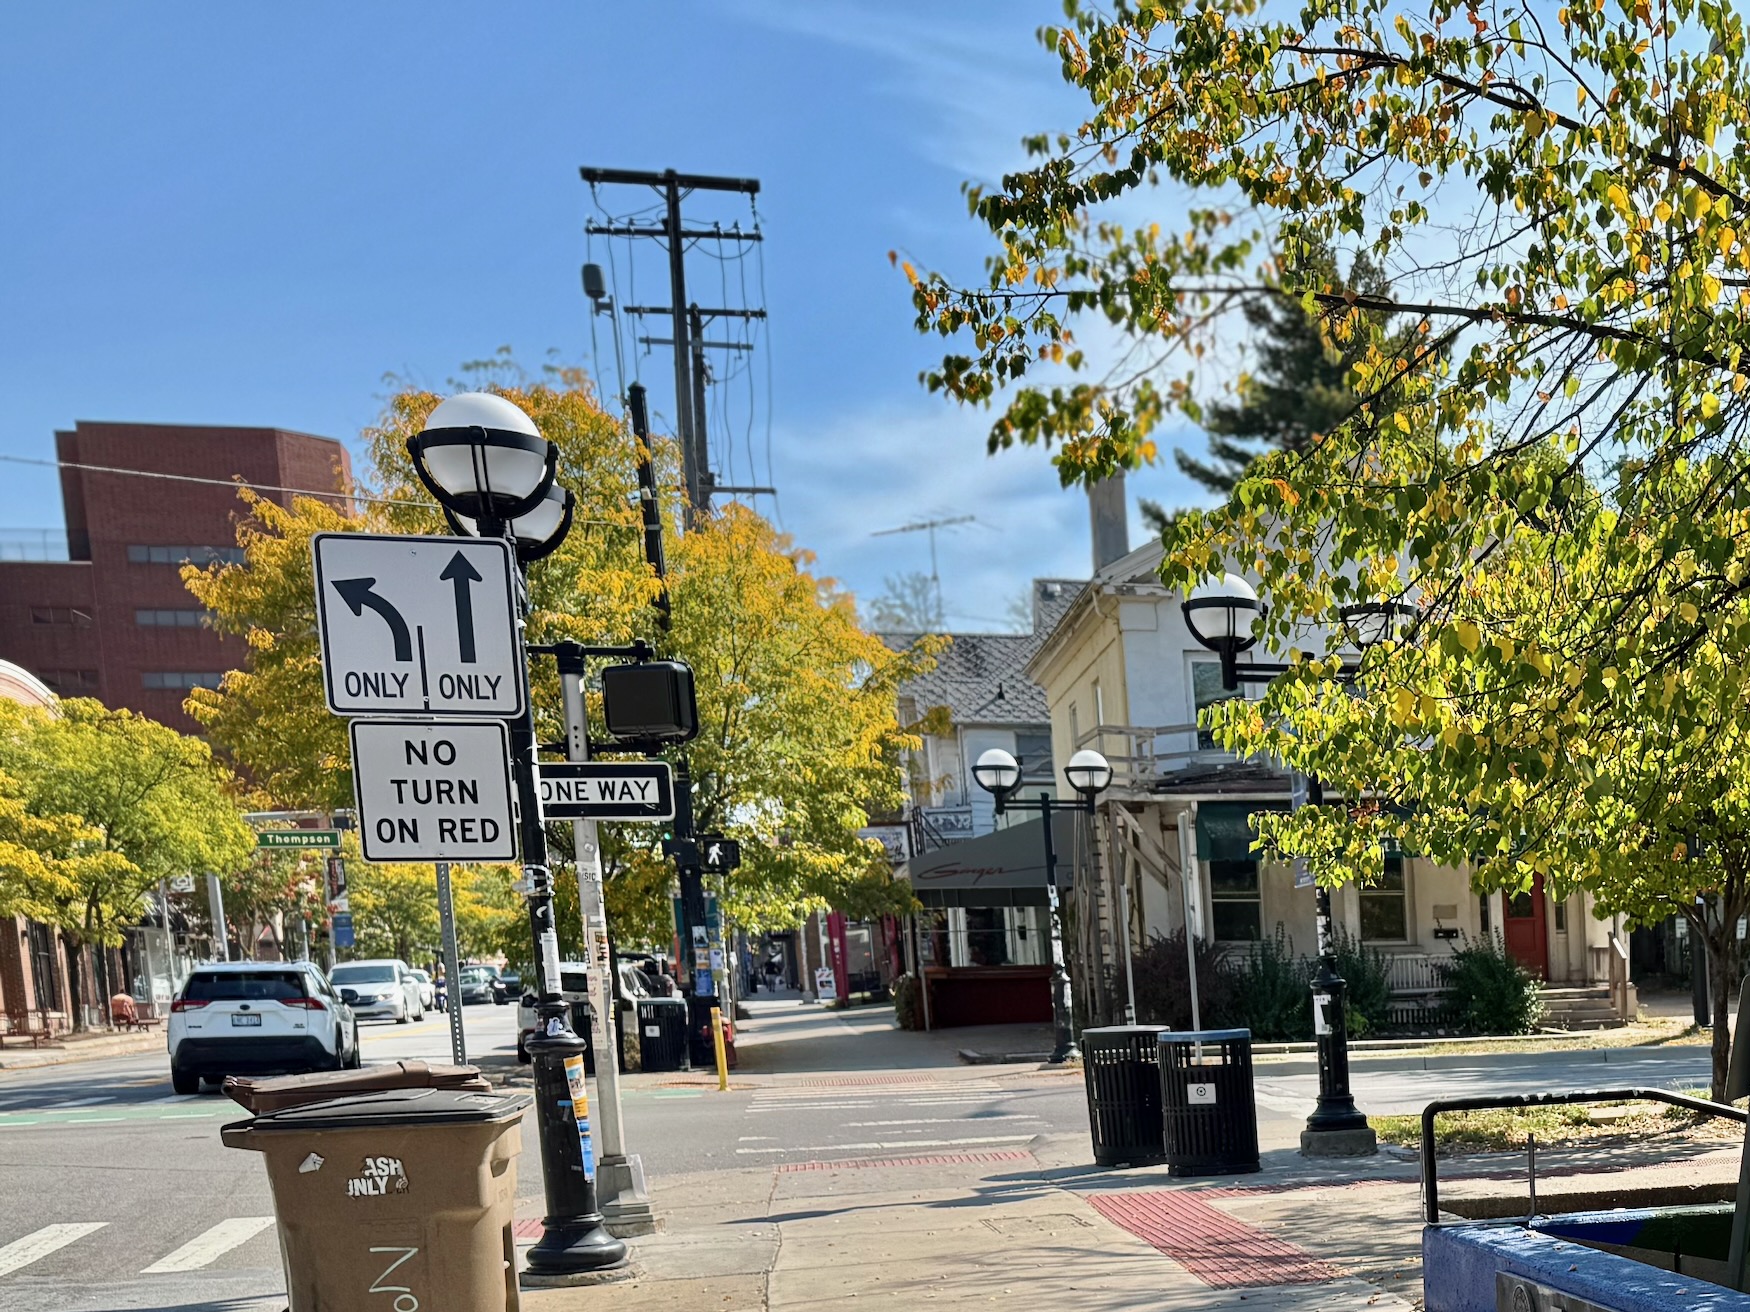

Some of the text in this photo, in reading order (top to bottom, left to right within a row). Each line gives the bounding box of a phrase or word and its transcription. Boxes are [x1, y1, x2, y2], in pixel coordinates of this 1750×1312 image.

[345, 671, 409, 698] ONLY
[439, 673, 502, 700] ONLY
[405, 740, 456, 766] NO
[390, 779, 478, 804] TURN
[541, 780, 650, 801] ONE WAY
[267, 834, 331, 845] Thompson
[377, 818, 499, 843] ON RED
